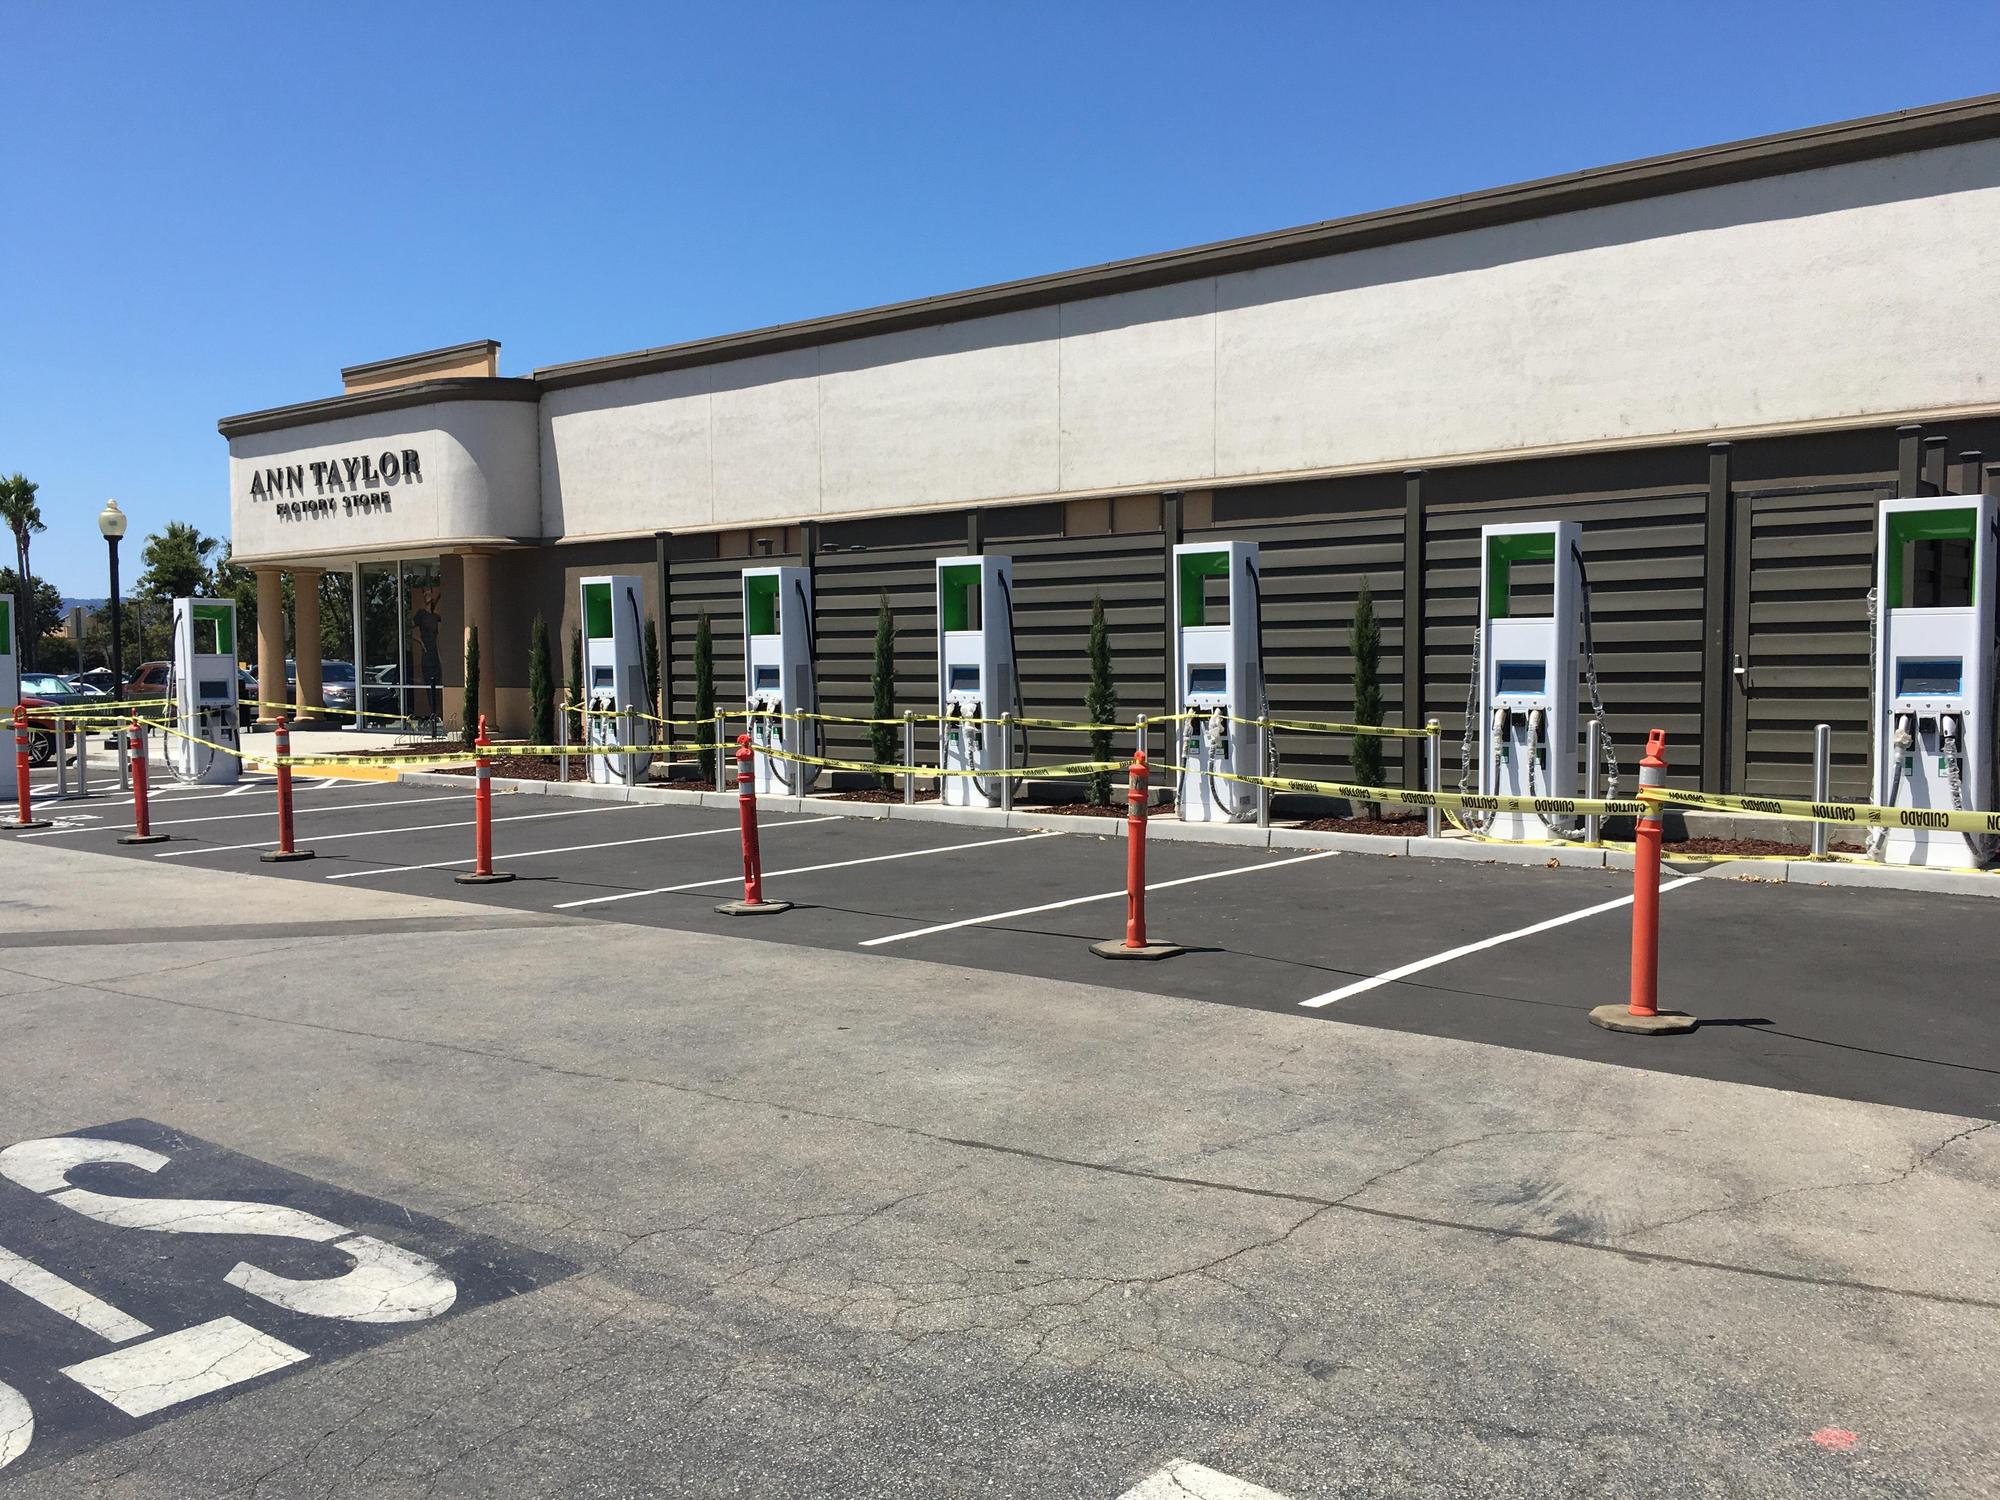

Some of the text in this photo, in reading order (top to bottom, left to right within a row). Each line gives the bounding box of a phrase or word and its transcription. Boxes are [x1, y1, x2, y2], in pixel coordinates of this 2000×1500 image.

[250, 449, 421, 496] ANN TAYLOR
[276, 491, 392, 515] FACTORY STORE
[1338, 786, 1371, 799] CAUTION
[1400, 792, 1436, 805] CUIDADO
[1460, 796, 1499, 810] CAUTION
[1534, 799, 1575, 812] CUIDADO
[1604, 801, 1647, 813] CAUTION
[1740, 798, 1783, 814] CUIDADO
[1811, 804, 1856, 822] CAUTION
[1900, 810, 1949, 828] CUIDADO
